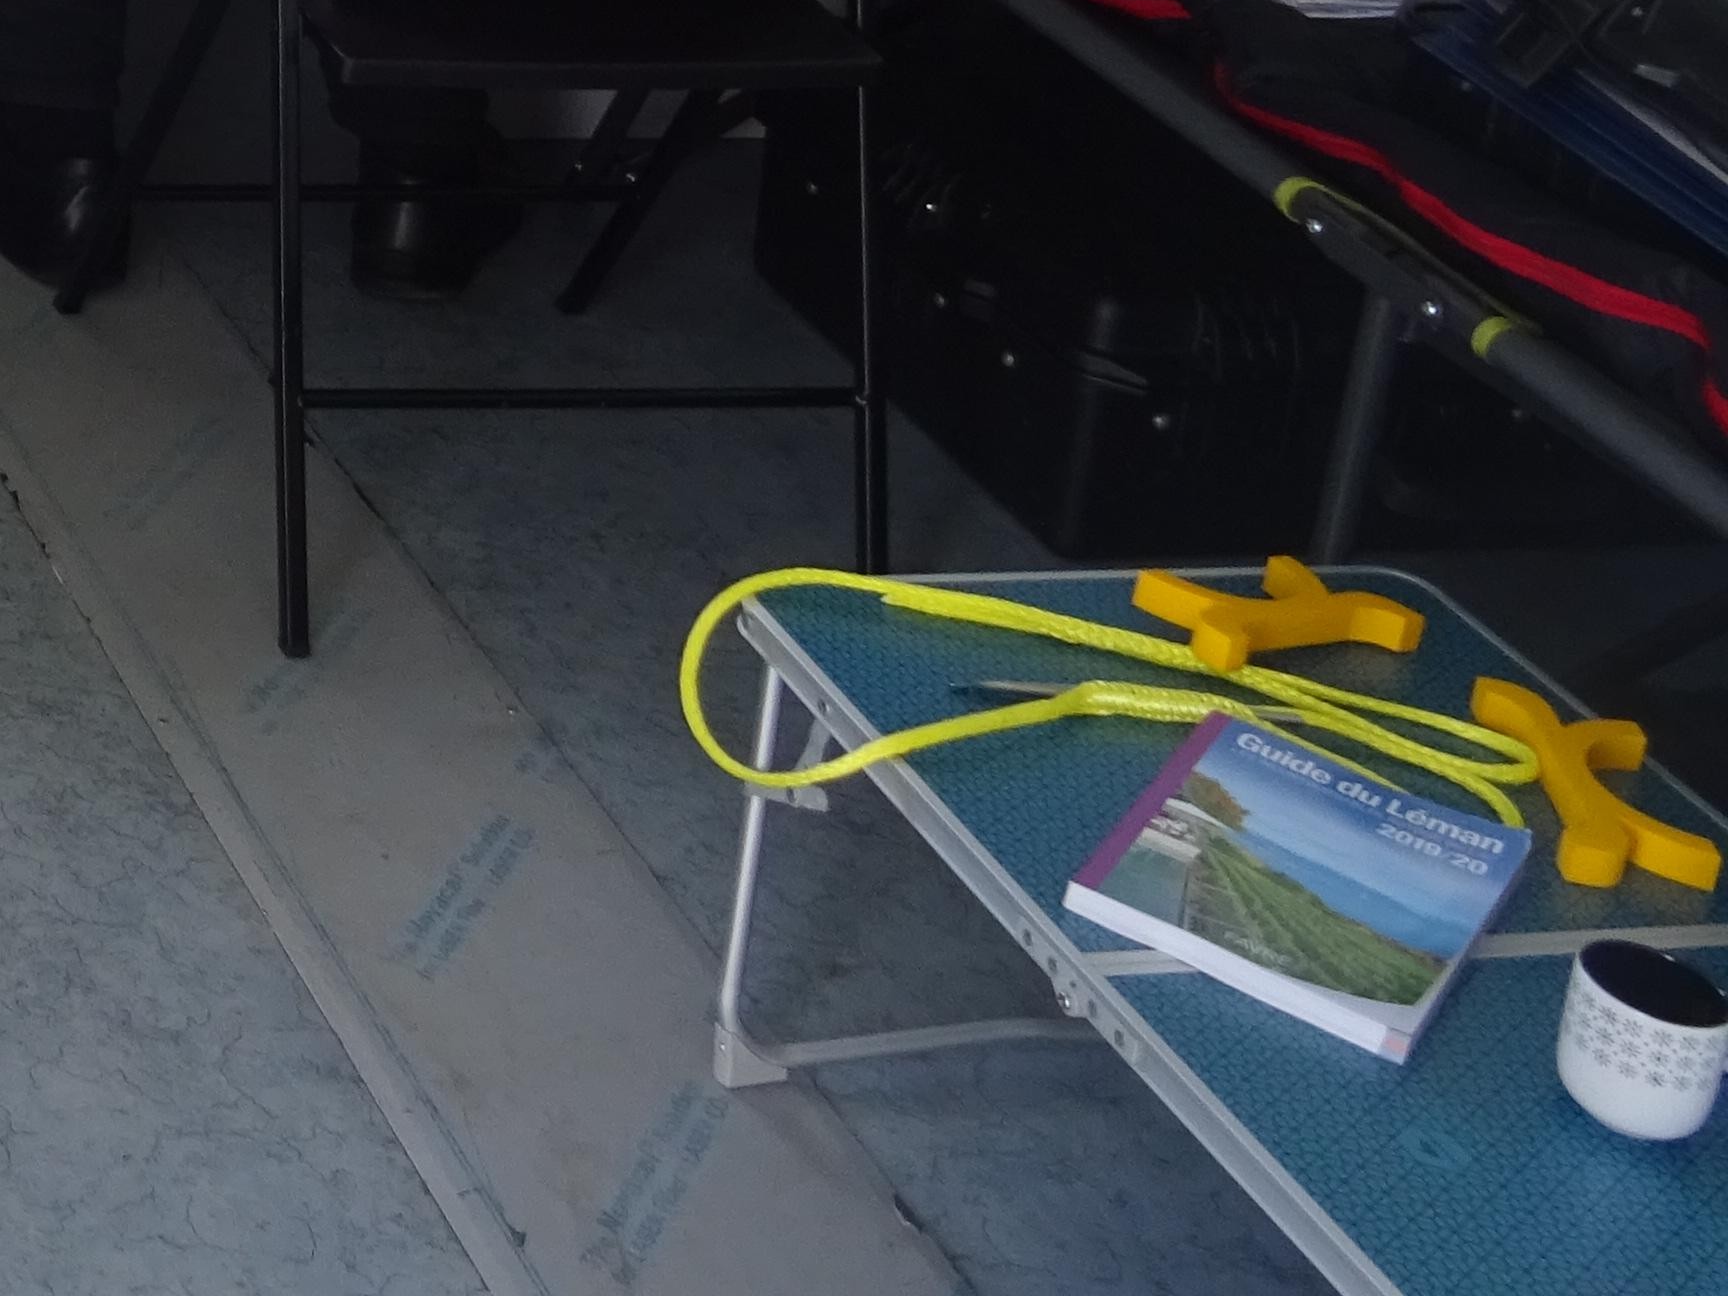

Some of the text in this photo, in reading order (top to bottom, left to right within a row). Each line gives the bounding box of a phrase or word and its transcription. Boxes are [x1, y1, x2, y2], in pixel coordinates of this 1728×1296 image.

[1236, 732, 1505, 855] Guide du Léman
